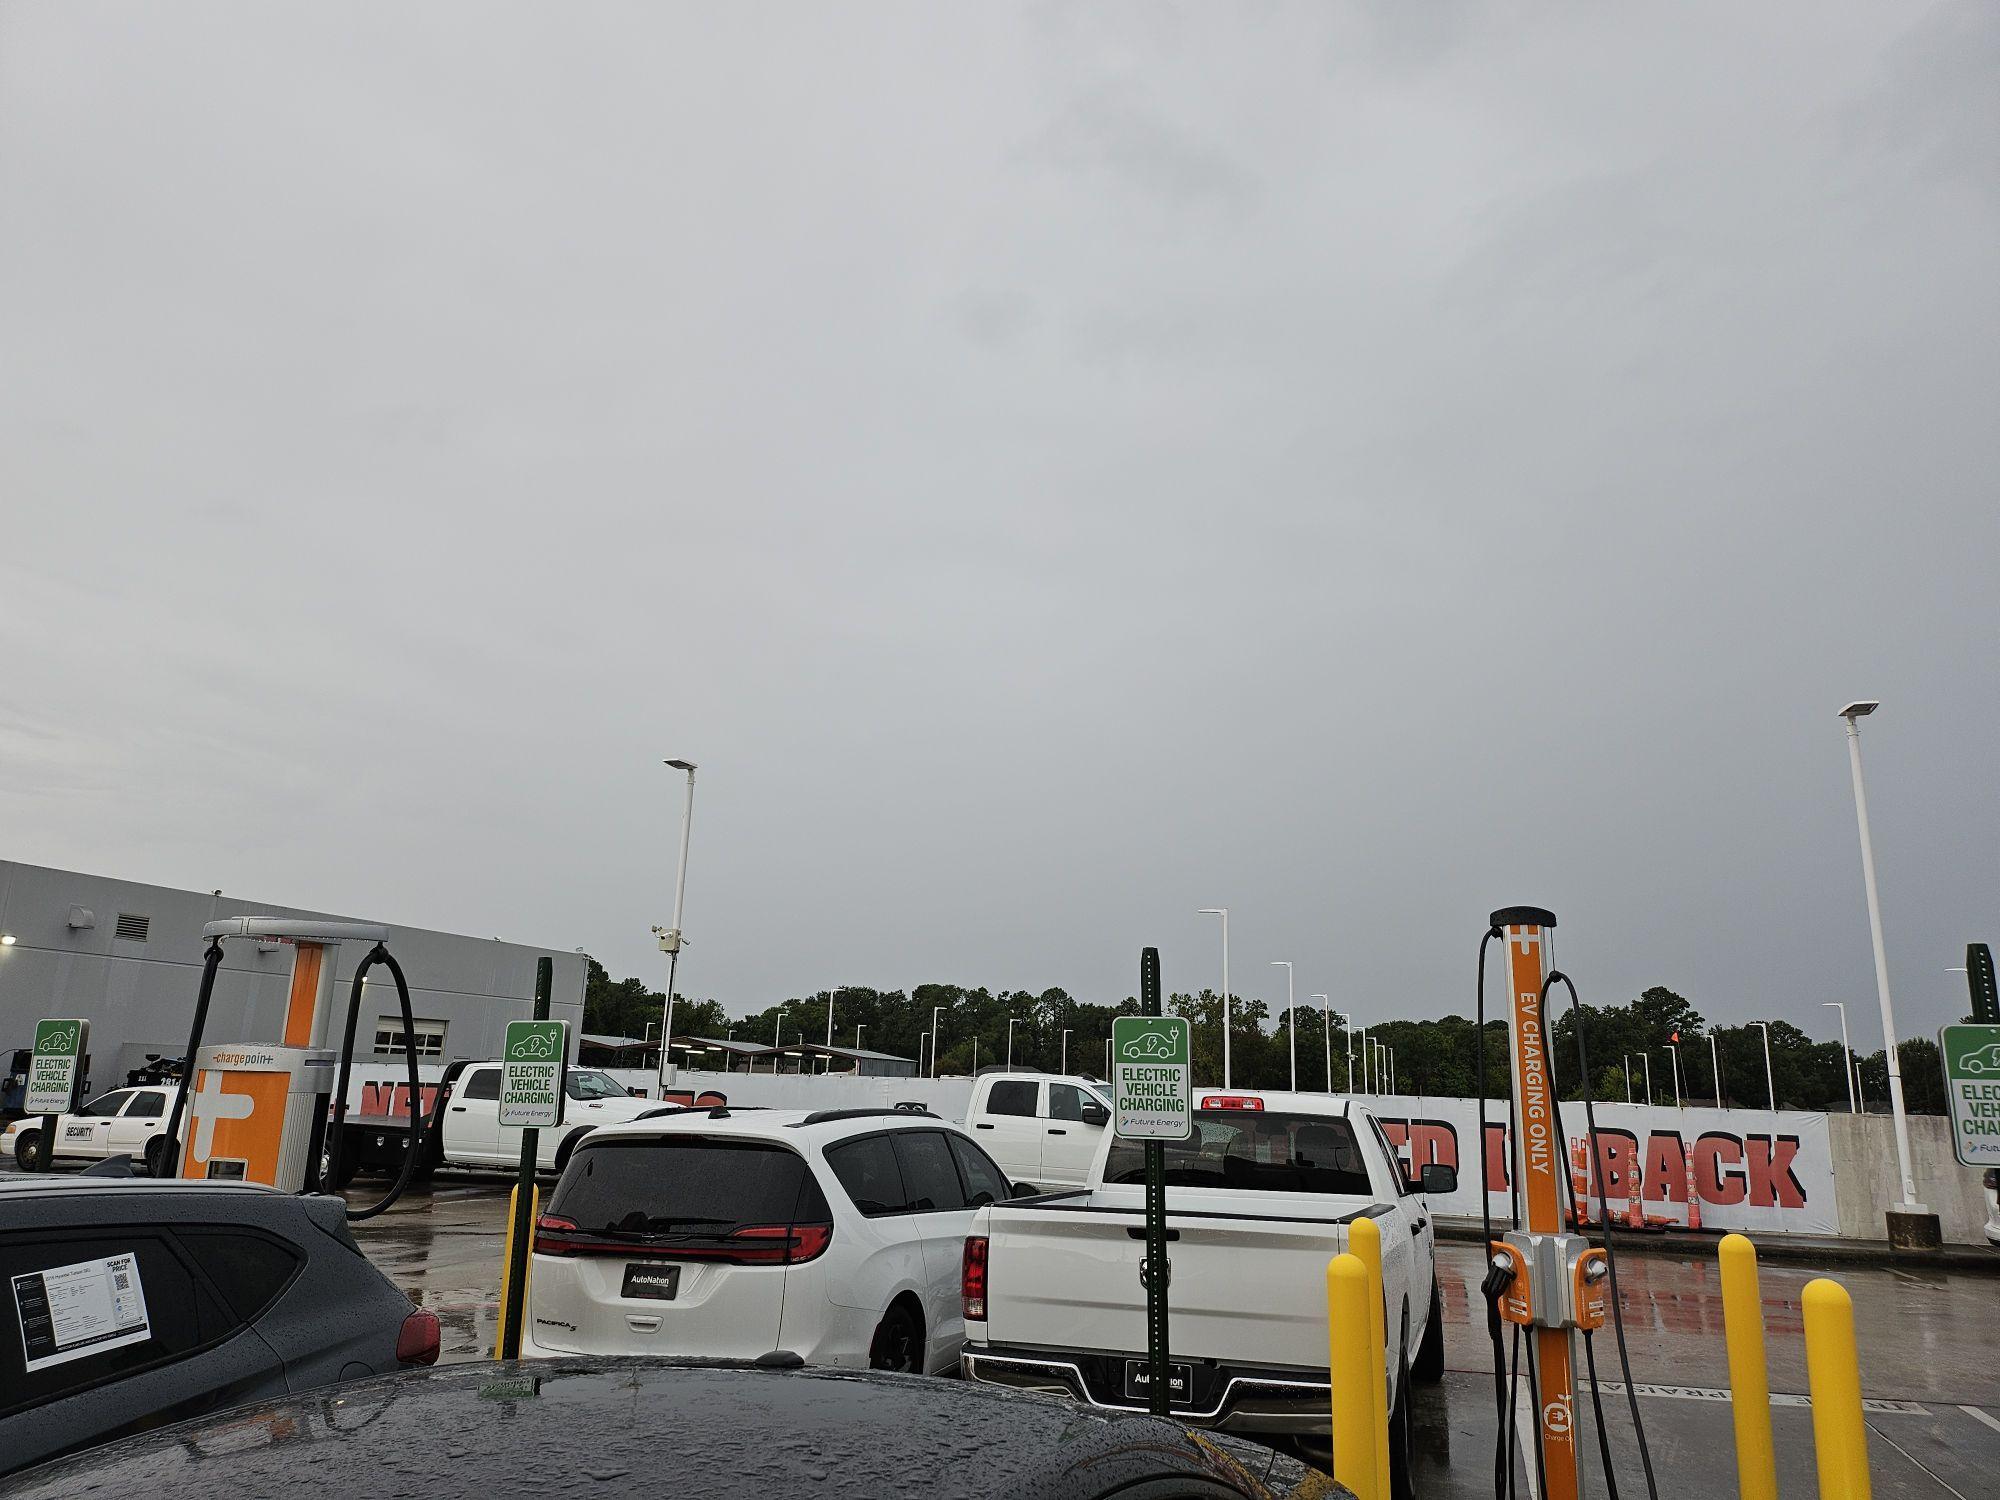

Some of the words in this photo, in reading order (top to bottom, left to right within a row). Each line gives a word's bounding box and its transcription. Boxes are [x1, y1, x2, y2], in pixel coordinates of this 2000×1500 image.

[1520, 993, 1538, 1016] EV
[35, 1058, 71, 1071] ELECTRIC
[1522, 1020, 1545, 1119] CHARGING
[36, 1070, 67, 1081] VEHICLE
[508, 1065, 555, 1078] ELECTRIC
[1122, 1067, 1181, 1082] ELECTRIC
[30, 1082, 69, 1093] CHARGING
[511, 1079, 551, 1091] VEHICLE
[1126, 1082, 1178, 1097] VEHICLE
[504, 1091, 555, 1104] CHARGING
[1120, 1097, 1185, 1112] CHARGING
[511, 1109, 530, 1117] Future
[530, 1110, 552, 1118] Energy
[1130, 1118, 1156, 1126] Future
[1156, 1119, 1184, 1128] Energy
[1962, 1118, 2000, 1136] CHA
[66, 1126, 93, 1137] SECURITY
[1529, 1123, 1549, 1175] ONLY
[1586, 1127, 1807, 1208] BACK
[106, 1260, 120, 1268] SCAN
[119, 1257, 131, 1266] FOR
[112, 1264, 128, 1273] PRICE
[631, 1274, 669, 1285] AutoNation
[536, 1318, 571, 1327] PACIFICA
